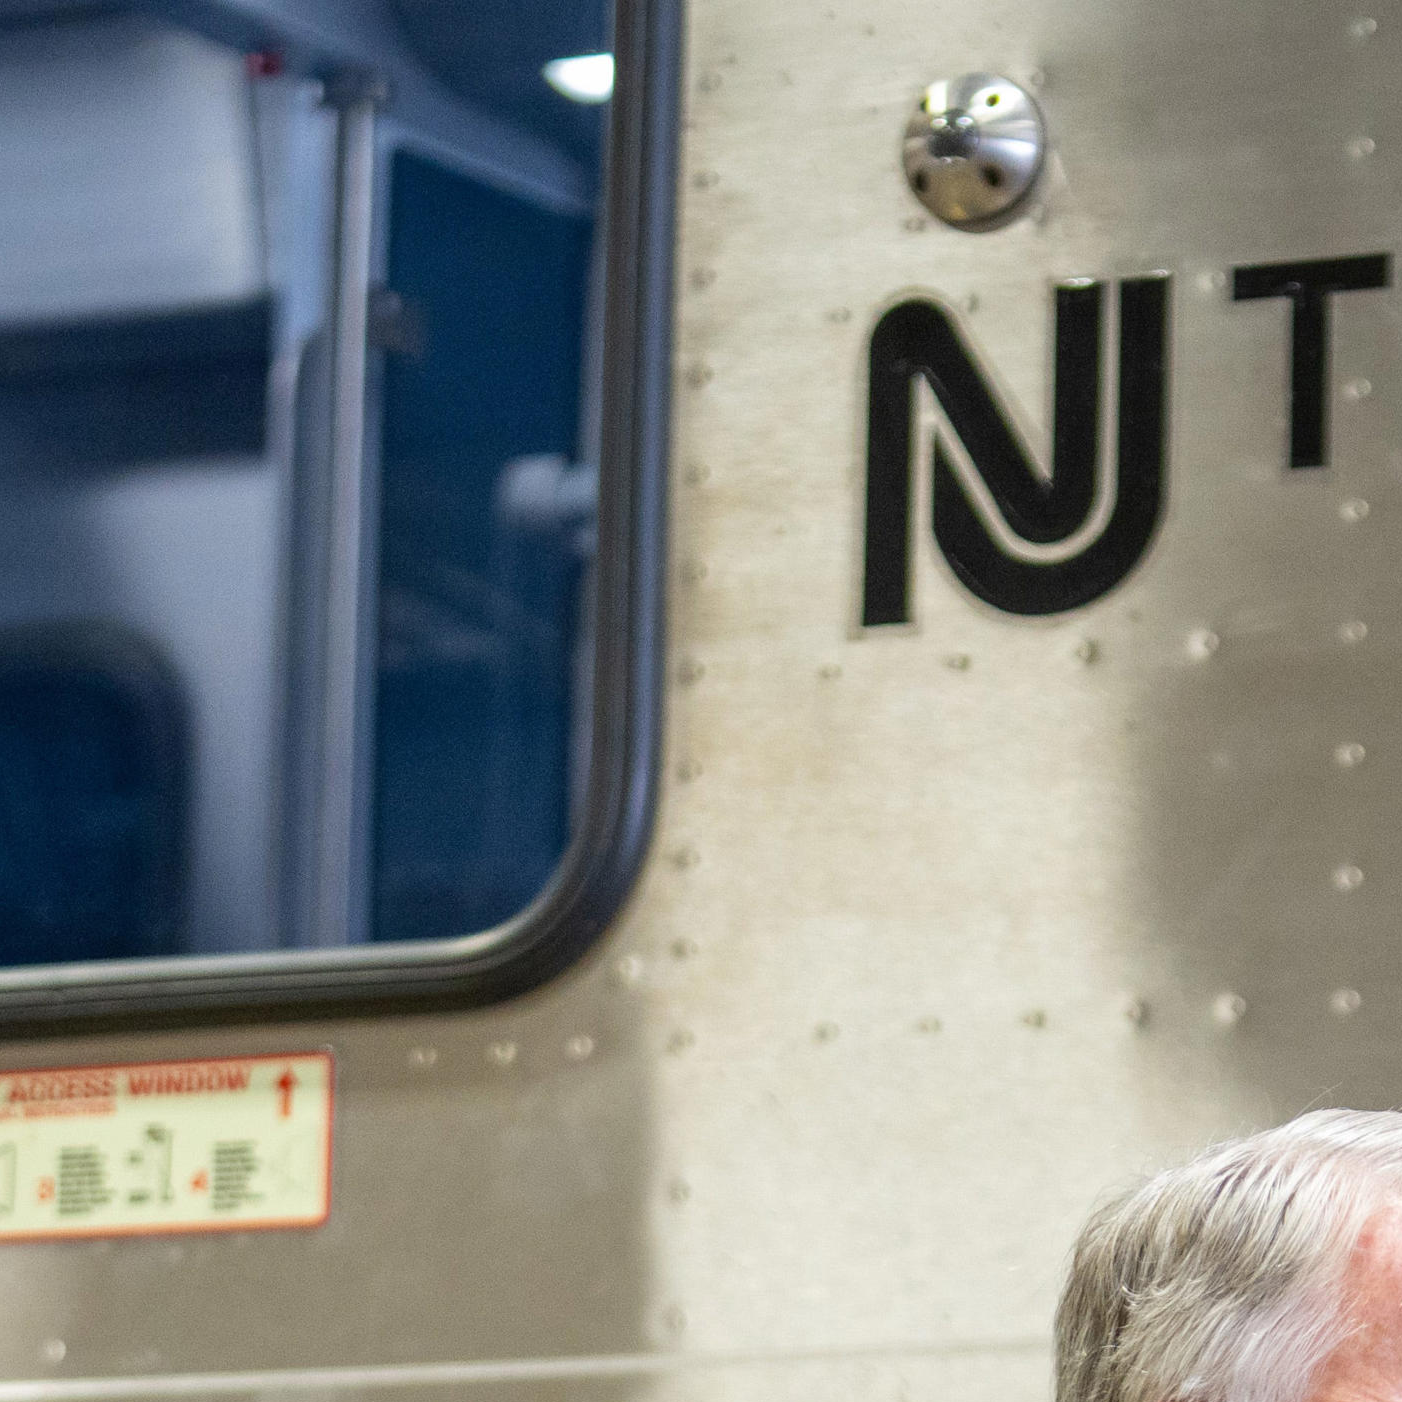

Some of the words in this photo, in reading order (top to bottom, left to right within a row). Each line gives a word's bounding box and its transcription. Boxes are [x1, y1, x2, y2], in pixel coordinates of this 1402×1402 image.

[862, 274, 1174, 627] NJ
[9, 1073, 117, 1102] ACCESS
[128, 1069, 252, 1096] WINDOW
